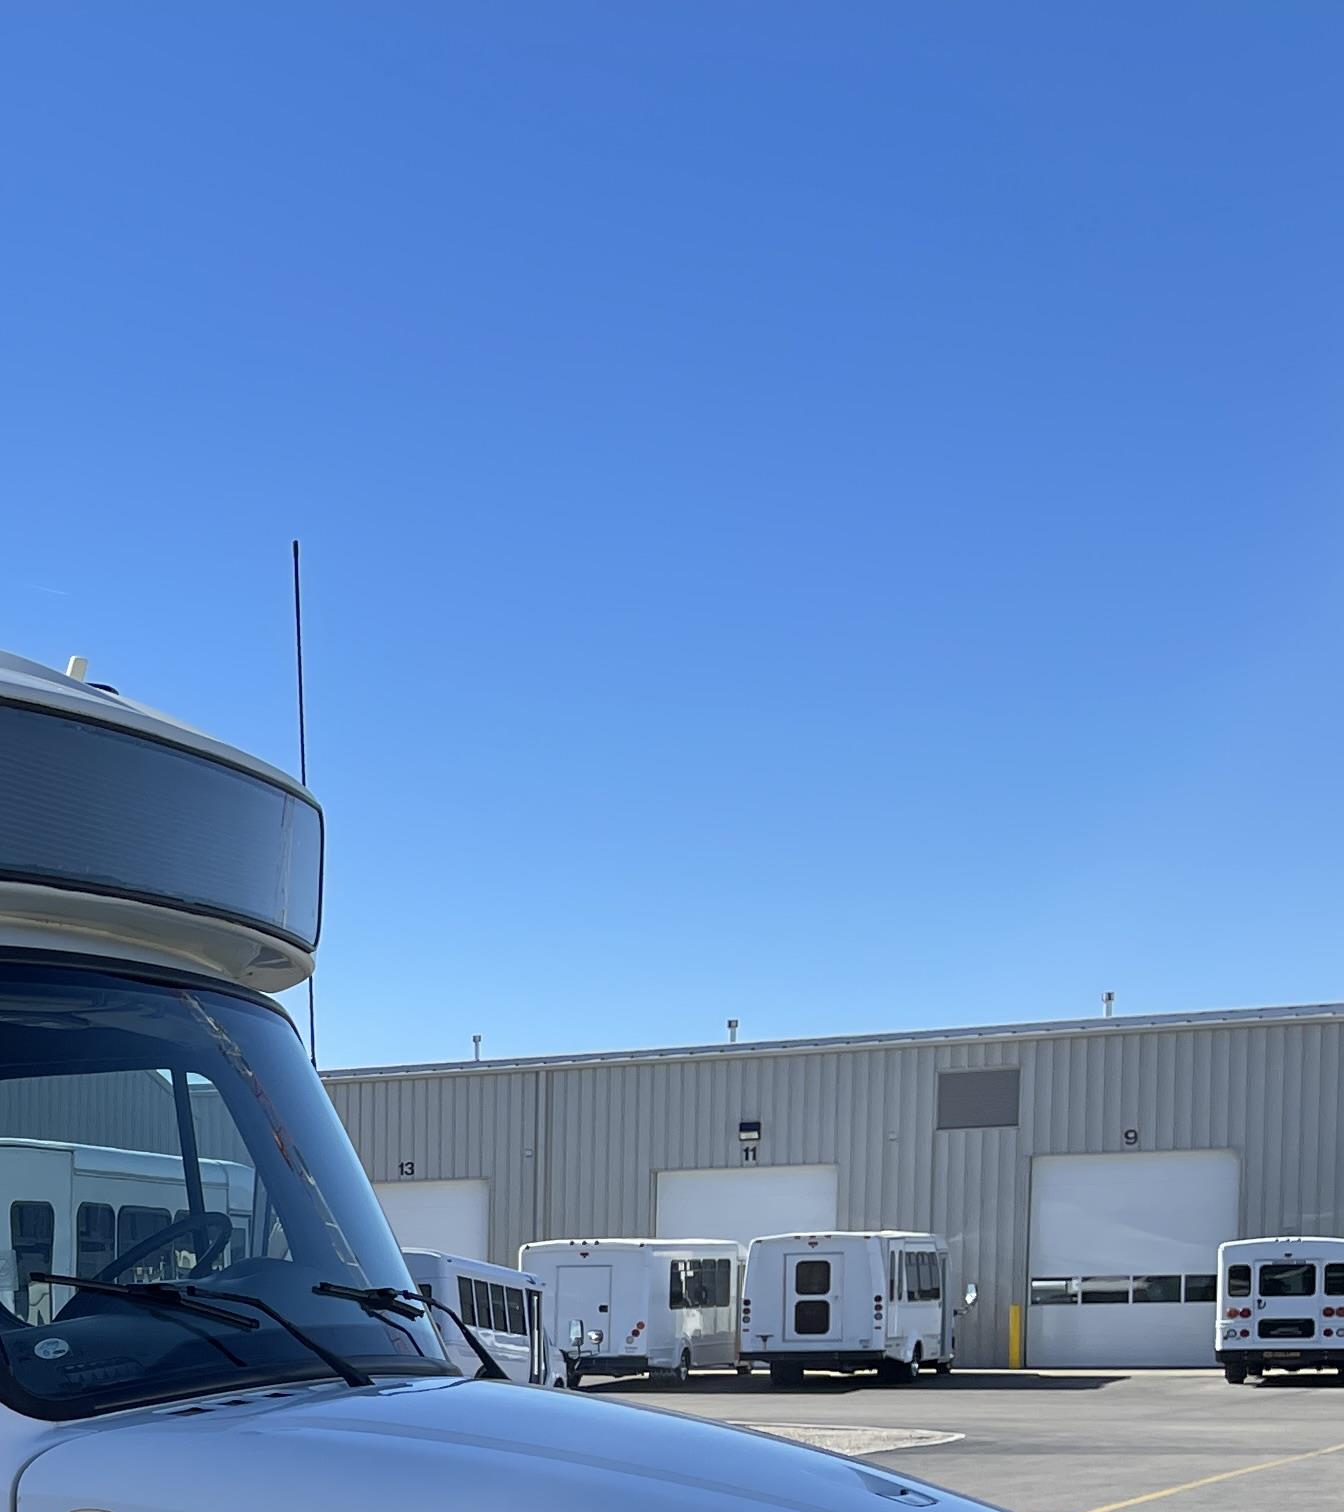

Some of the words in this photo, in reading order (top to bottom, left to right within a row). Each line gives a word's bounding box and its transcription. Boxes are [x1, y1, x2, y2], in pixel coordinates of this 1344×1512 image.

[1124, 1129, 1138, 1145] 9
[743, 1146, 757, 1161] 11
[398, 1161, 415, 1176] 13
